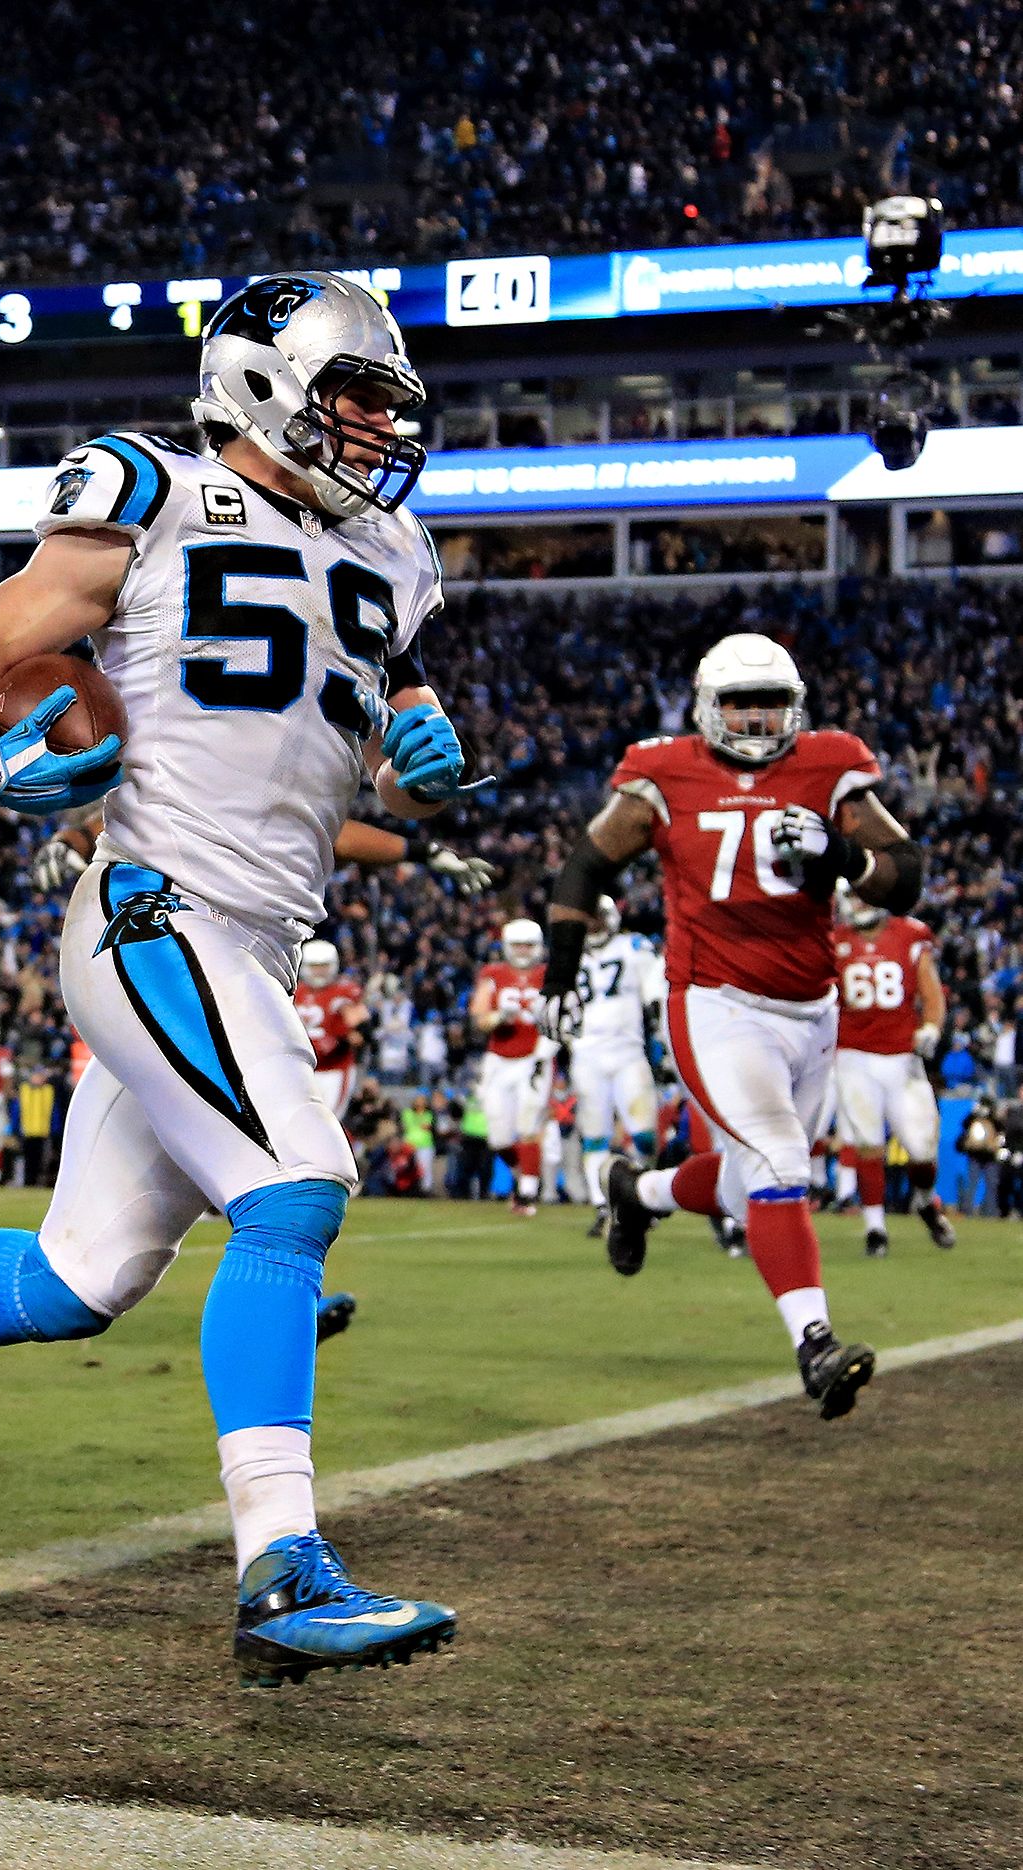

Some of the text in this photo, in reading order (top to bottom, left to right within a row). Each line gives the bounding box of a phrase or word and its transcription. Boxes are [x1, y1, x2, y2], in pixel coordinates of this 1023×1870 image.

[205, 485, 243, 515] C
[179, 541, 401, 738] 59
[843, 961, 905, 1010] 68
